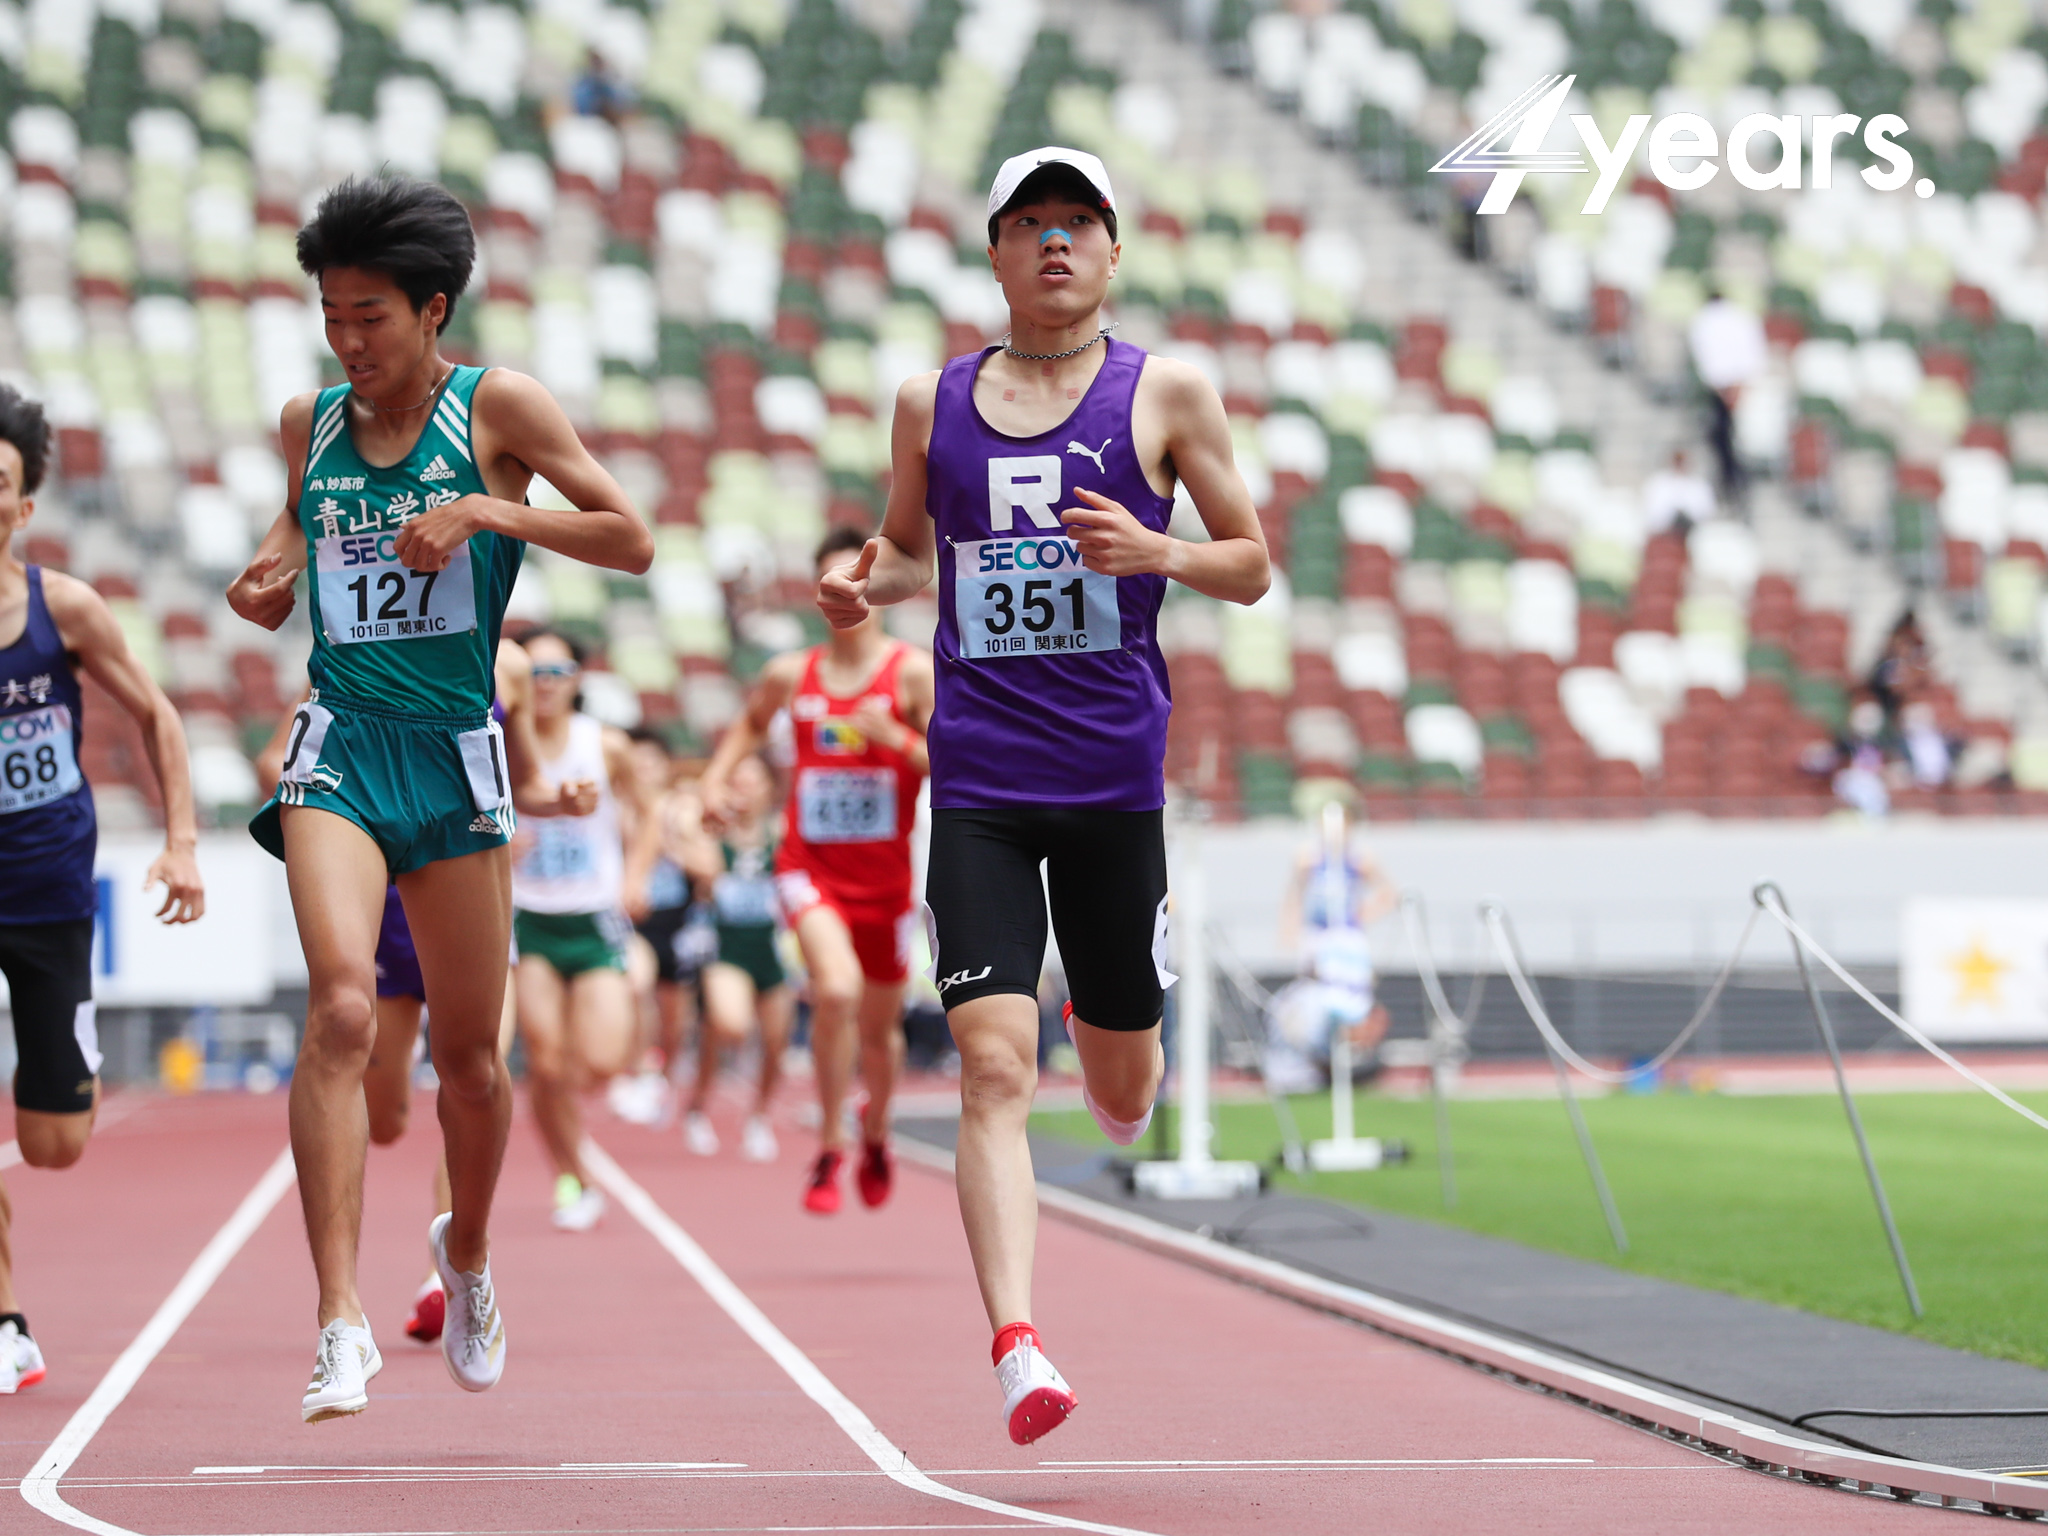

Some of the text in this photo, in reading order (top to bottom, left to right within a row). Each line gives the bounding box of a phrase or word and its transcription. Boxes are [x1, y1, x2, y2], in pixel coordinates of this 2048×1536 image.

[326, 476, 366, 491] 妙高市
[419, 469, 457, 483] adidas
[988, 454, 1062, 532] R
[341, 533, 400, 566] SEC
[348, 569, 439, 622] 127
[984, 578, 1086, 635] 351
[349, 616, 447, 639] 101回 関東IC
[984, 633, 1088, 653] 101回 関東IC
[0, 712, 54, 744] COM
[0, 744, 57, 790] 68
[469, 822, 502, 836] adidas
